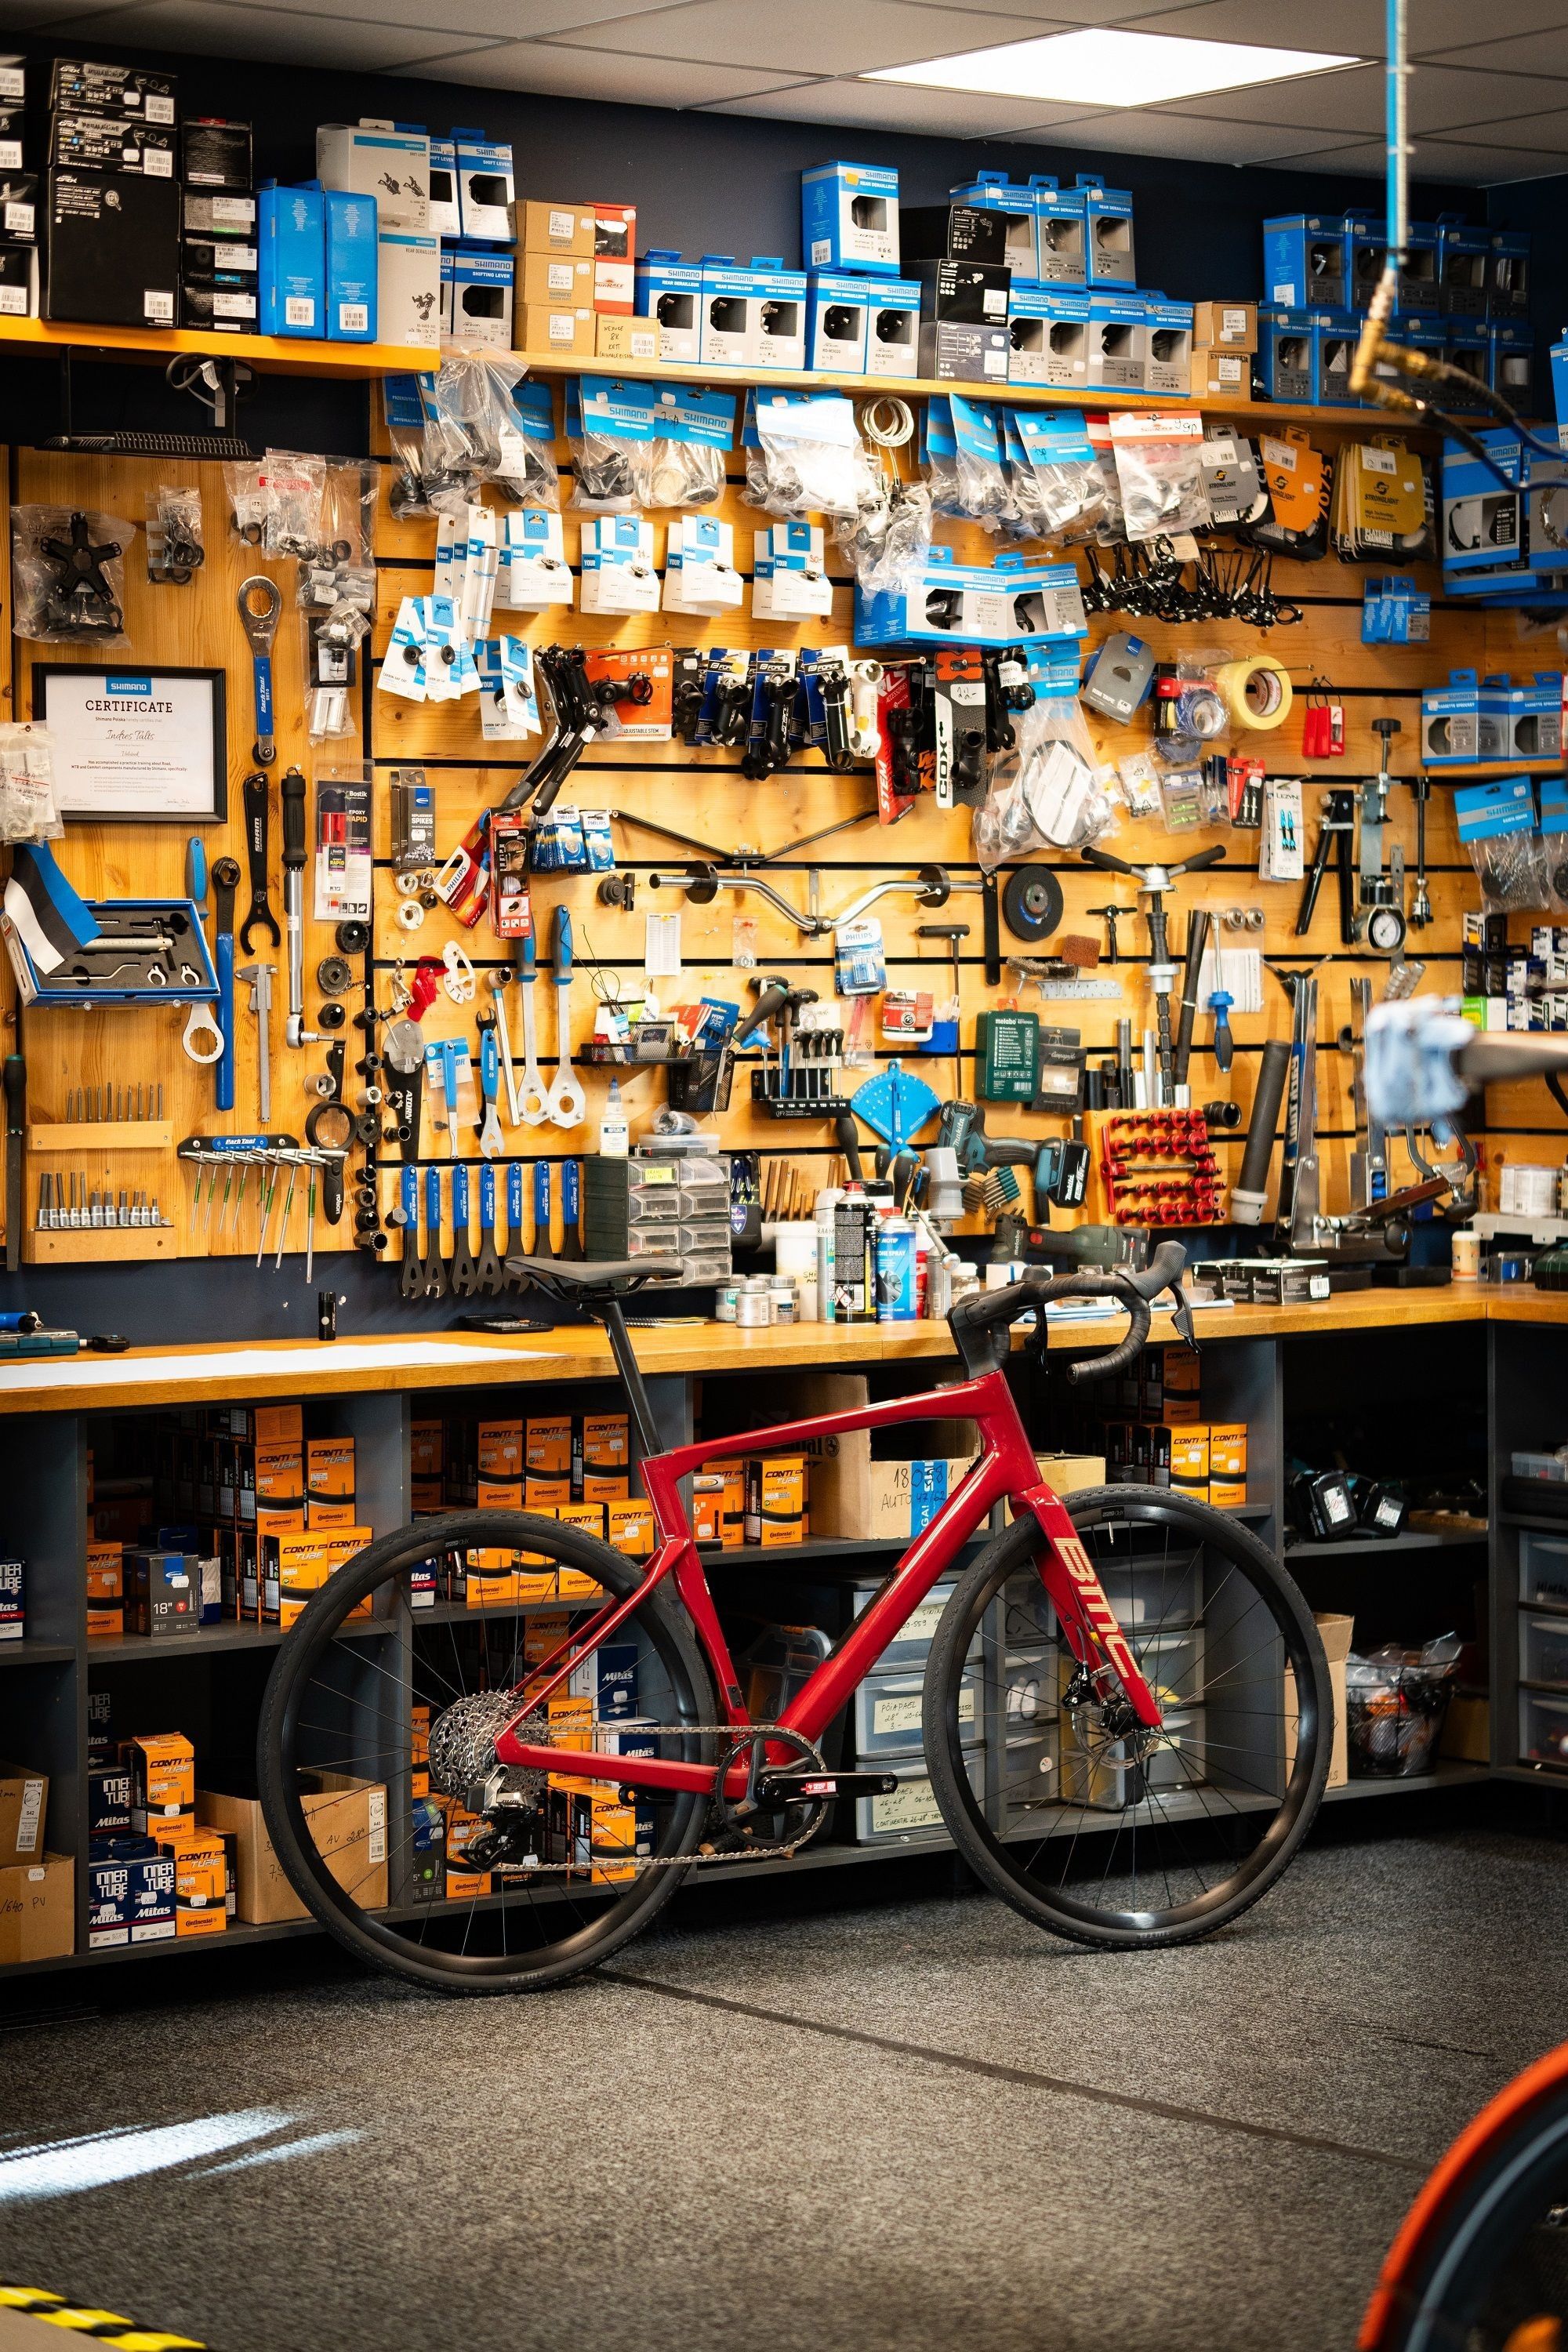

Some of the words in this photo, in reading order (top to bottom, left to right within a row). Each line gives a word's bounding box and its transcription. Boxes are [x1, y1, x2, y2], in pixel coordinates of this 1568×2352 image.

[866, 171, 896, 181] SHIMANO
[873, 182, 897, 191] DERAILLEUR
[1003, 191, 1033, 201] SHIMANO
[474, 260, 510, 270] SHIMANO
[668, 270, 700, 279] SHIMANO
[721, 274, 753, 282] SHIMANO
[771, 278, 804, 286] SHIMANO
[836, 281, 867, 291] SHIMANO
[887, 287, 919, 296] SHIMANO
[1019, 295, 1048, 304] SHIMANO
[1060, 299, 1089, 309] SHIMANO
[1115, 299, 1145, 309] SHIMANO
[1162, 307, 1192, 316] SHIMANO
[609, 407, 648, 419] SHIMANO
[684, 412, 728, 428] SHIMANO
[1364, 494, 1399, 505] STRONGLIGHT
[974, 574, 1006, 583] SHIMANO
[1047, 569, 1076, 578] SHIMANO
[768, 663, 787, 672] FORCE
[1041, 669, 1074, 677] SHIMANO
[85, 699, 173, 713] CERTIFICATE
[877, 759, 890, 812] STEM
[446, 866, 467, 893] PHILIPS
[845, 931, 873, 942] PHILIPS
[528, 1426, 560, 1436] CONTI
[586, 1423, 618, 1432] CONTI
[541, 1433, 568, 1442] TUBE
[311, 1449, 343, 1457] CONTI
[259, 1454, 289, 1464] CONTI
[323, 1455, 352, 1465] TUBE
[765, 1469, 793, 1479] CONTI
[318, 1512, 343, 1522] Continental
[267, 1518, 292, 1528] Continental
[282, 1544, 315, 1555] CONTI
[296, 1552, 324, 1561] TUBE
[1054, 1537, 1143, 1679] BMC
[602, 1671, 633, 1682] Mitas
[150, 1758, 182, 1769] CONTI
[162, 1765, 191, 1774] TUBE
[96, 1816, 130, 1828] Mitas
[157, 1823, 183, 1833] Continental
[177, 1852, 212, 1862] CONTI
[191, 1858, 221, 1868] TUBE
[143, 1863, 174, 1878] INNER
[96, 1869, 129, 1886] INNER
[146, 1875, 174, 1892] TUBE
[99, 1883, 129, 1899] TUBE
[135, 1907, 171, 1918] Mitas
[185, 1918, 213, 1928] Continental
